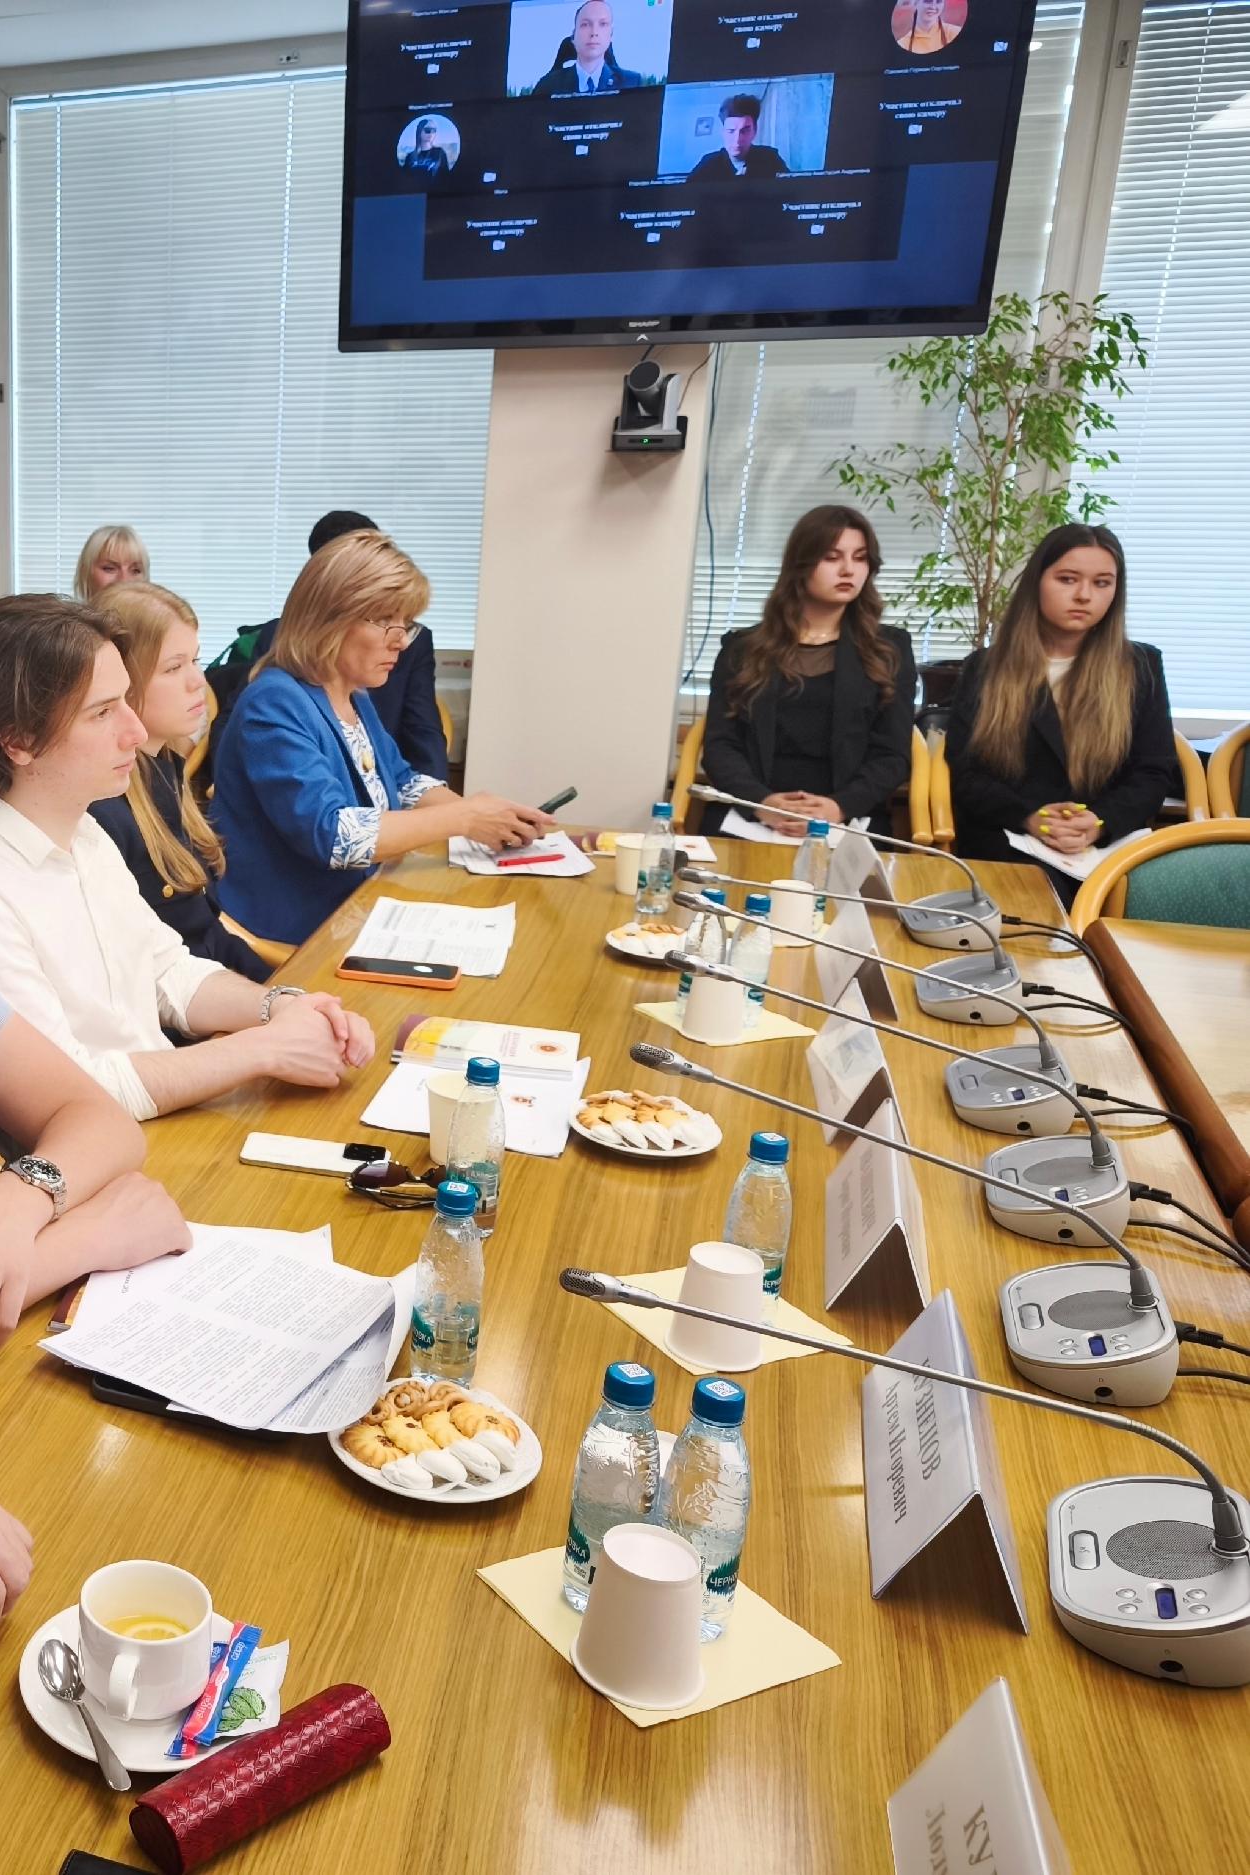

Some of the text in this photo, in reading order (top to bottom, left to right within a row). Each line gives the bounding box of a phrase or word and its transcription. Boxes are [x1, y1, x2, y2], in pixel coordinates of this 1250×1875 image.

[882, 1380, 908, 1525] Артем Игоревич
[963, 1800, 997, 1875] КУ
